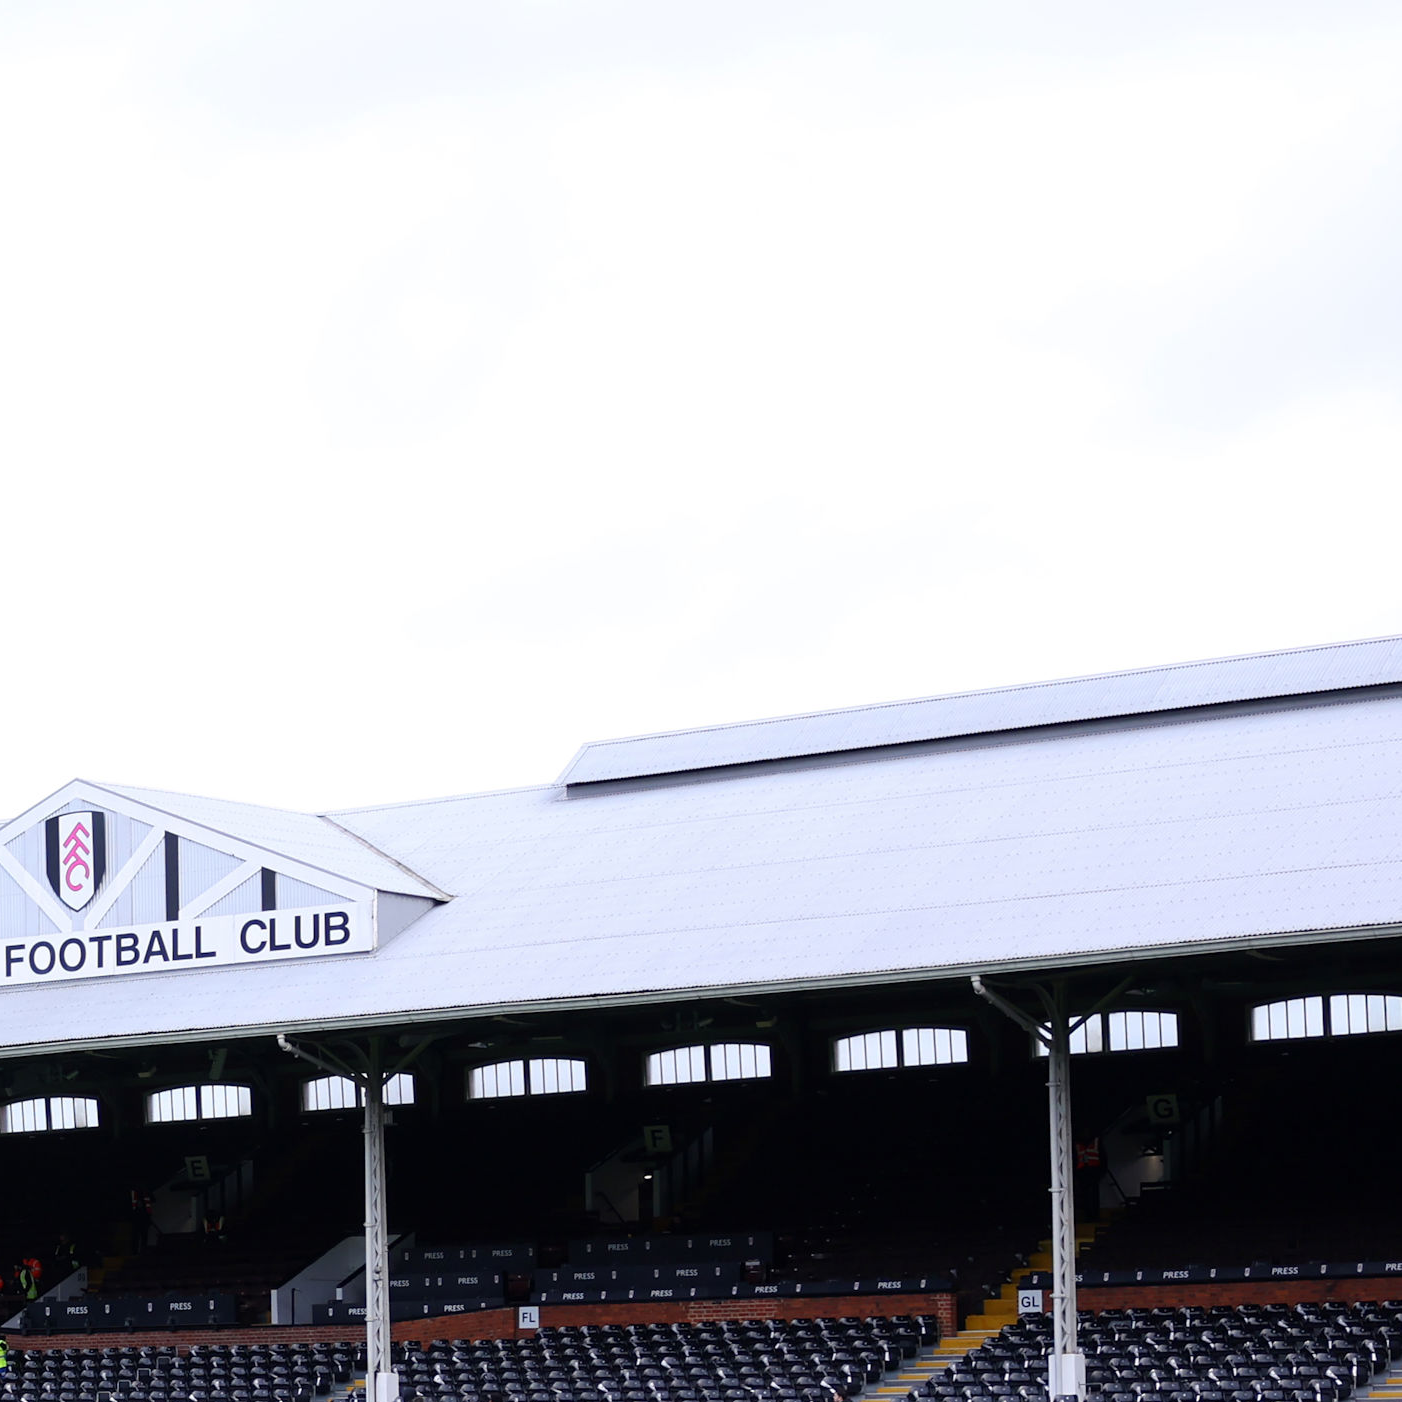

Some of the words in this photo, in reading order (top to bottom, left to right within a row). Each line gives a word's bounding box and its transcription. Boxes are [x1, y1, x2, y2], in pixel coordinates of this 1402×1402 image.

[4, 926, 217, 977] FOOTBALL
[240, 911, 351, 954] CLUB
[1154, 1099, 1173, 1118] G
[651, 1129, 664, 1148] F
[191, 1160, 205, 1177] E
[607, 1243, 629, 1251] PRESS
[708, 1238, 732, 1248] PRESS
[676, 1269, 699, 1277] PRESS
[1162, 1270, 1189, 1279] PRESS
[1271, 1266, 1299, 1275] PRESS
[458, 1277, 479, 1285] PRESS
[573, 1273, 596, 1281] PRESS
[754, 1285, 779, 1294] PRESS
[877, 1280, 902, 1290] PRESS
[562, 1292, 585, 1301] PRESS
[650, 1289, 673, 1298] PRESS
[1021, 1296, 1040, 1307] GL
[66, 1306, 89, 1315] PRESS
[169, 1302, 192, 1311] PRESS
[443, 1303, 465, 1312] PRESS
[522, 1312, 536, 1323] FL
